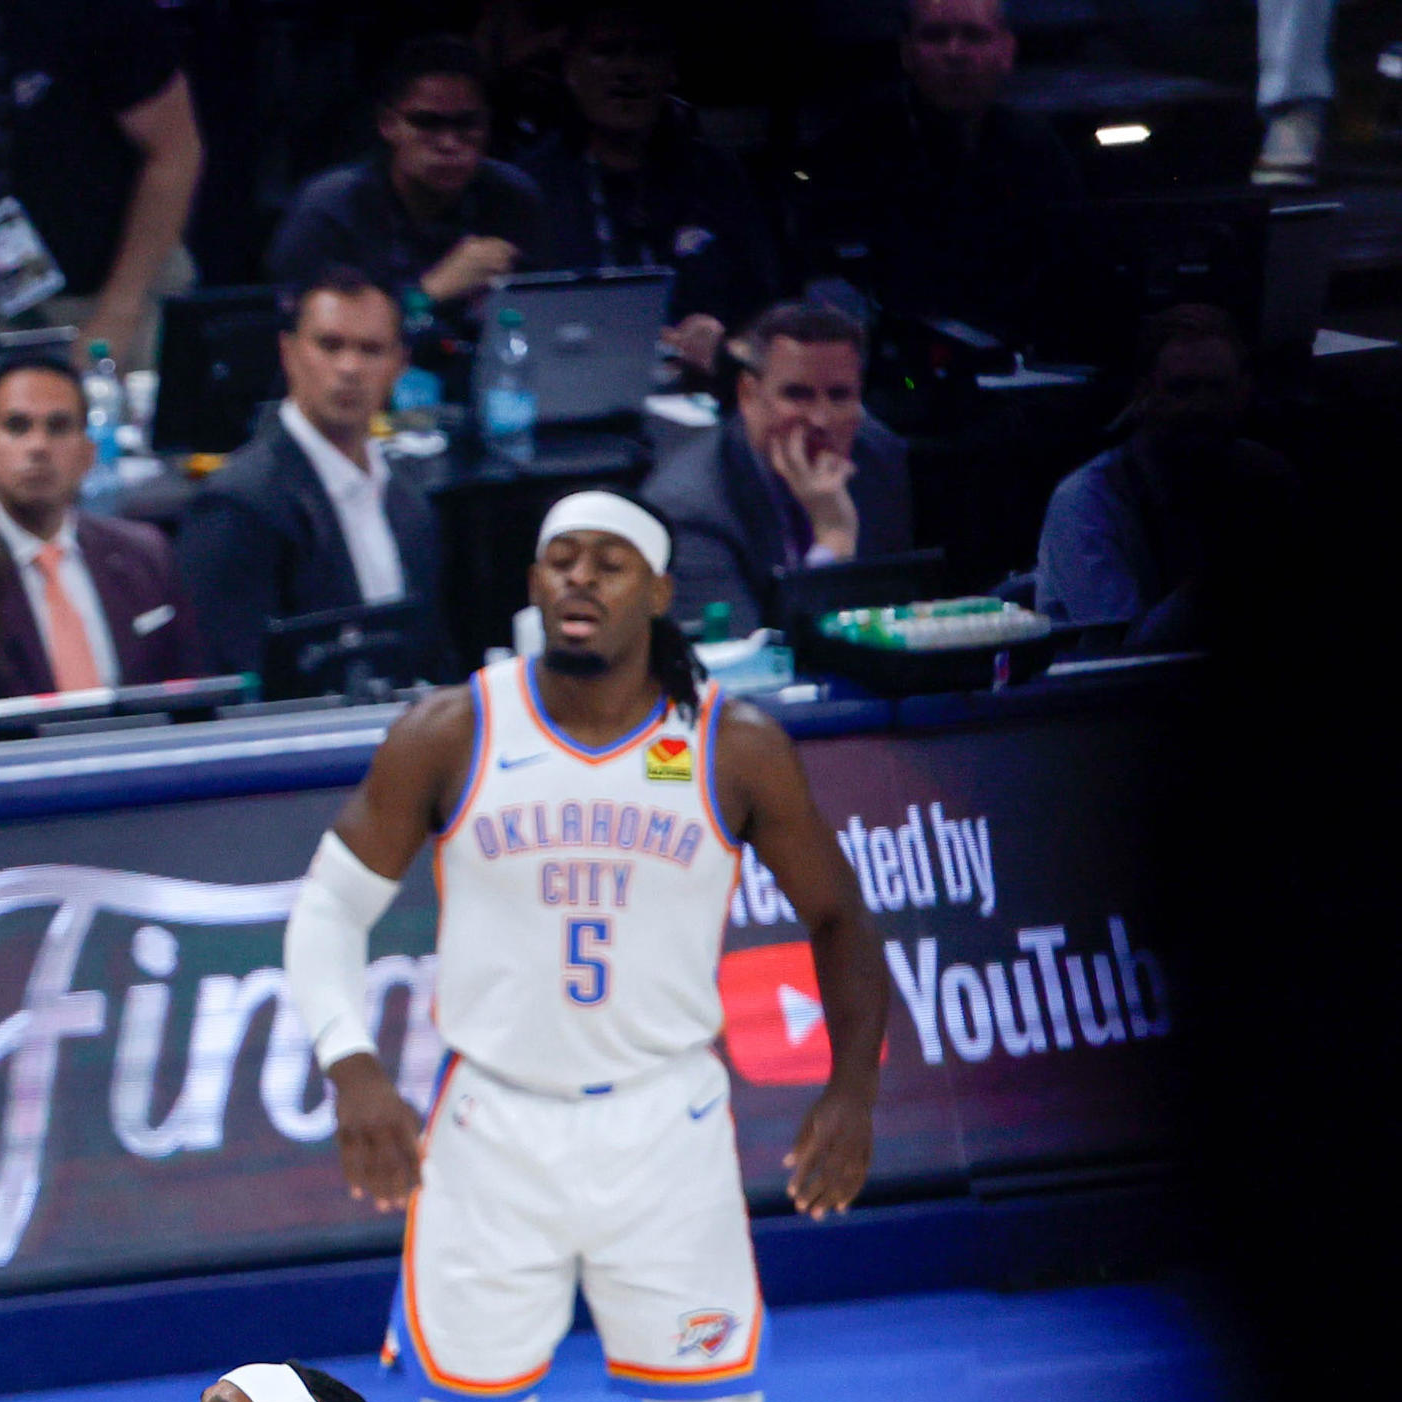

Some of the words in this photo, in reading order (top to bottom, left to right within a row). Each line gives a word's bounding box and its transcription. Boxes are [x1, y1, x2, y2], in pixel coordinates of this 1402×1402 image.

[473, 799, 704, 869] OKLAHOMA
[538, 858, 635, 908] CITY
[929, 801, 996, 918] by
[562, 912, 614, 1012] 5
[883, 914, 1173, 1065] YouTub
